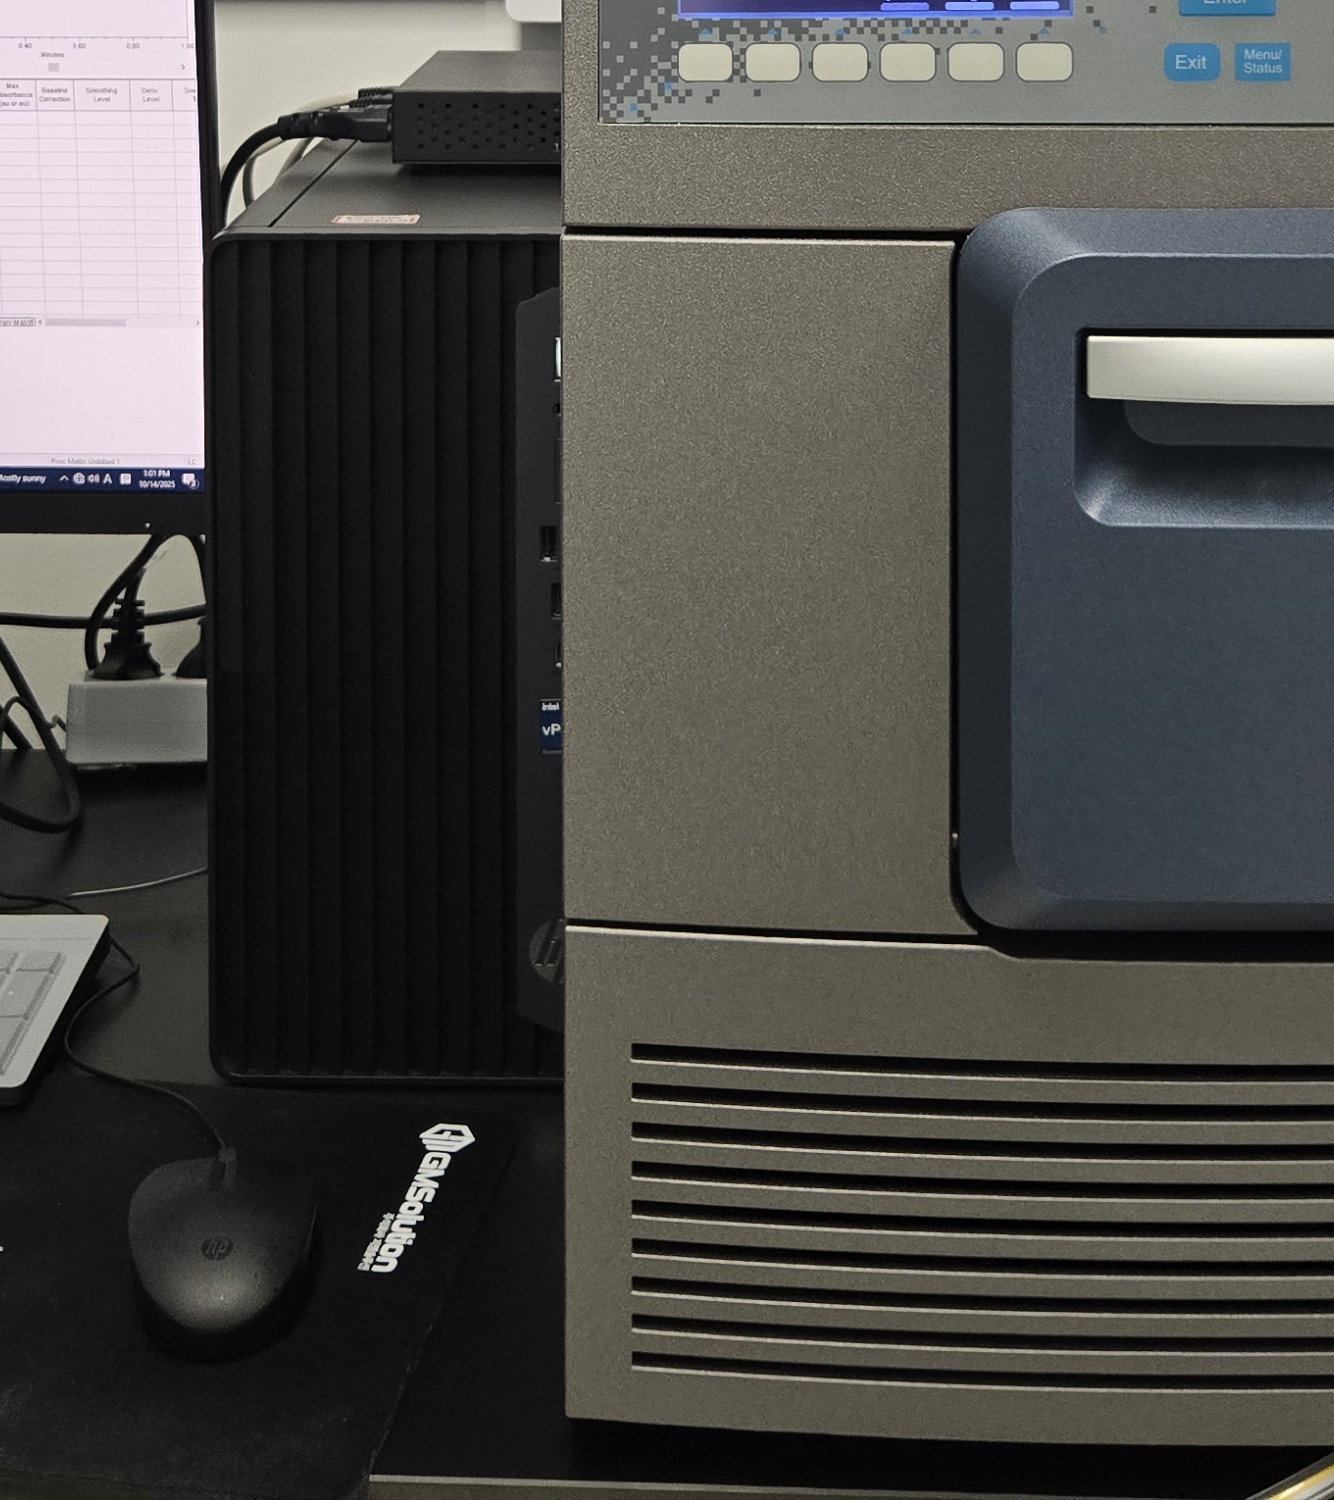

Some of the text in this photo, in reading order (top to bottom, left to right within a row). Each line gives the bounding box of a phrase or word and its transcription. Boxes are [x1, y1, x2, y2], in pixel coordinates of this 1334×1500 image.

[1243, 48, 1282, 61] Menu/
[1175, 54, 1207, 70] Exit
[1243, 62, 1283, 74] Status
[23, 473, 47, 484] sunny
[371, 1151, 453, 1273] GMSolution
